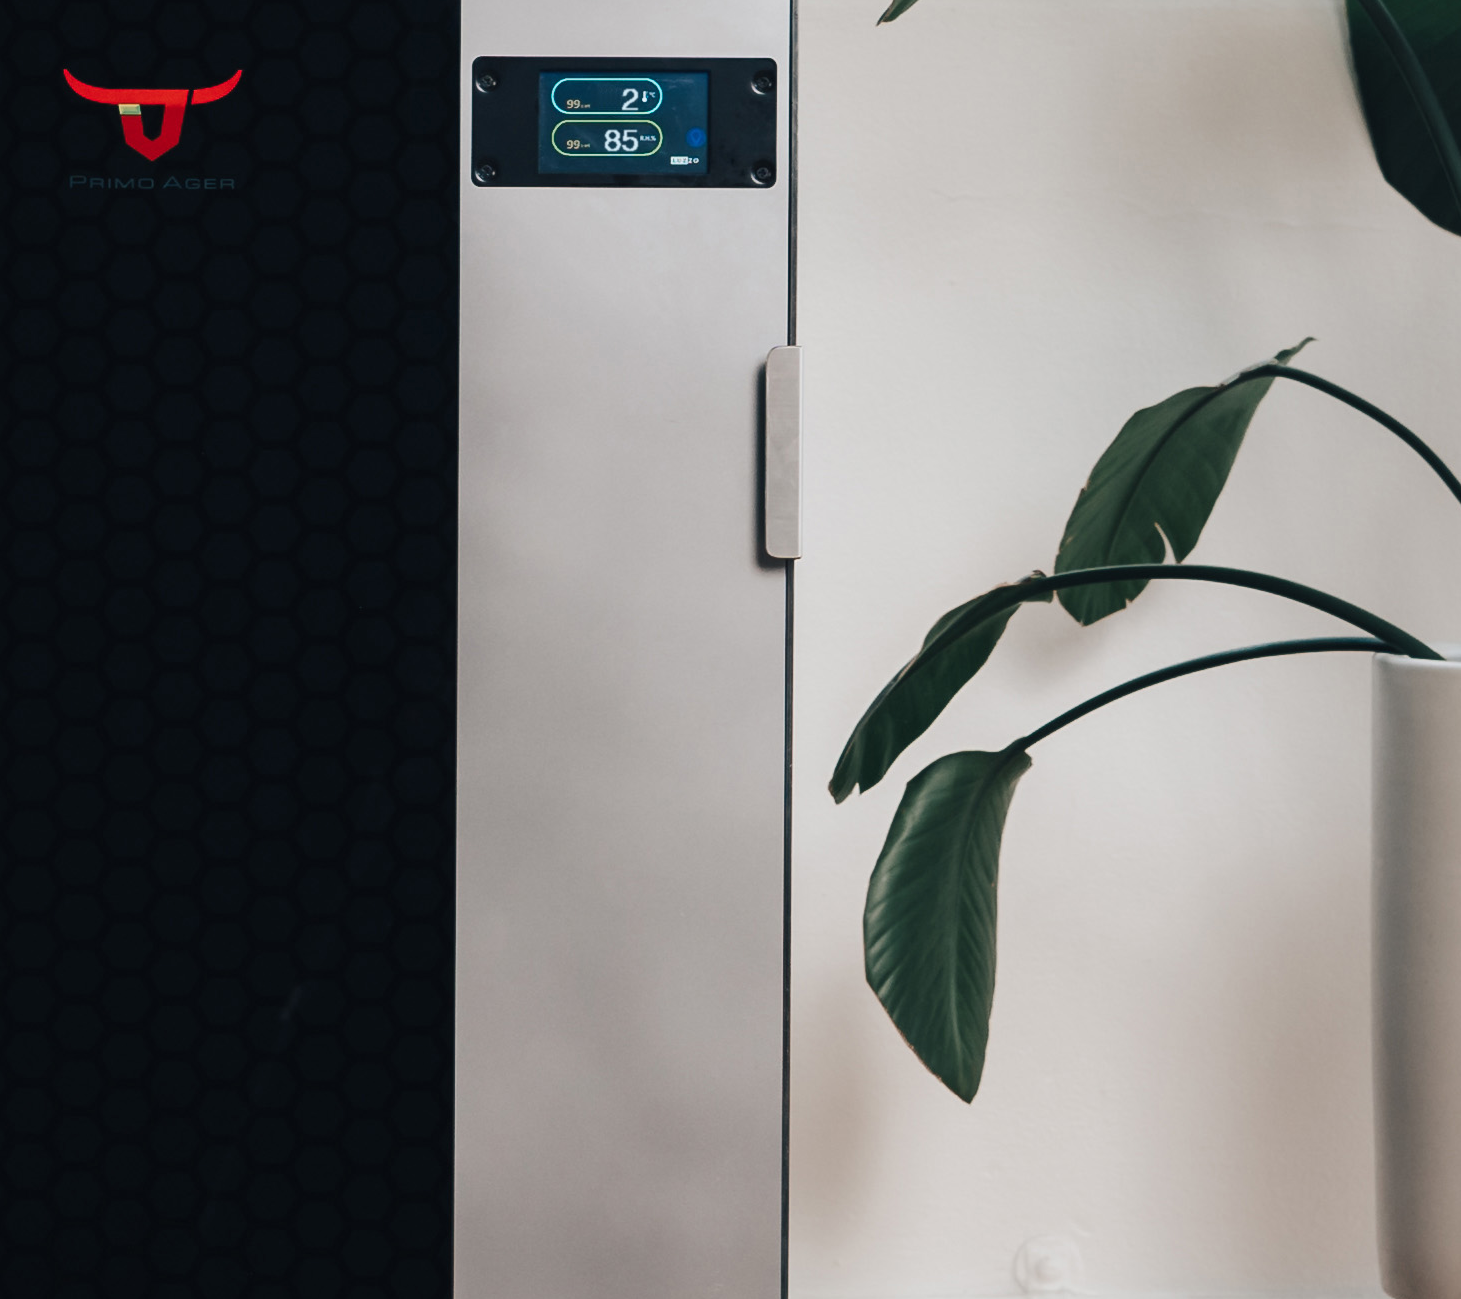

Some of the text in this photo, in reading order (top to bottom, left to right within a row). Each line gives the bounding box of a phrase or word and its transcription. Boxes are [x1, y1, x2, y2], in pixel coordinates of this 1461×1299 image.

[566, 99, 580, 109] 99
[622, 88, 639, 111] 2
[566, 139, 580, 149] 99
[604, 129, 639, 152] 85
